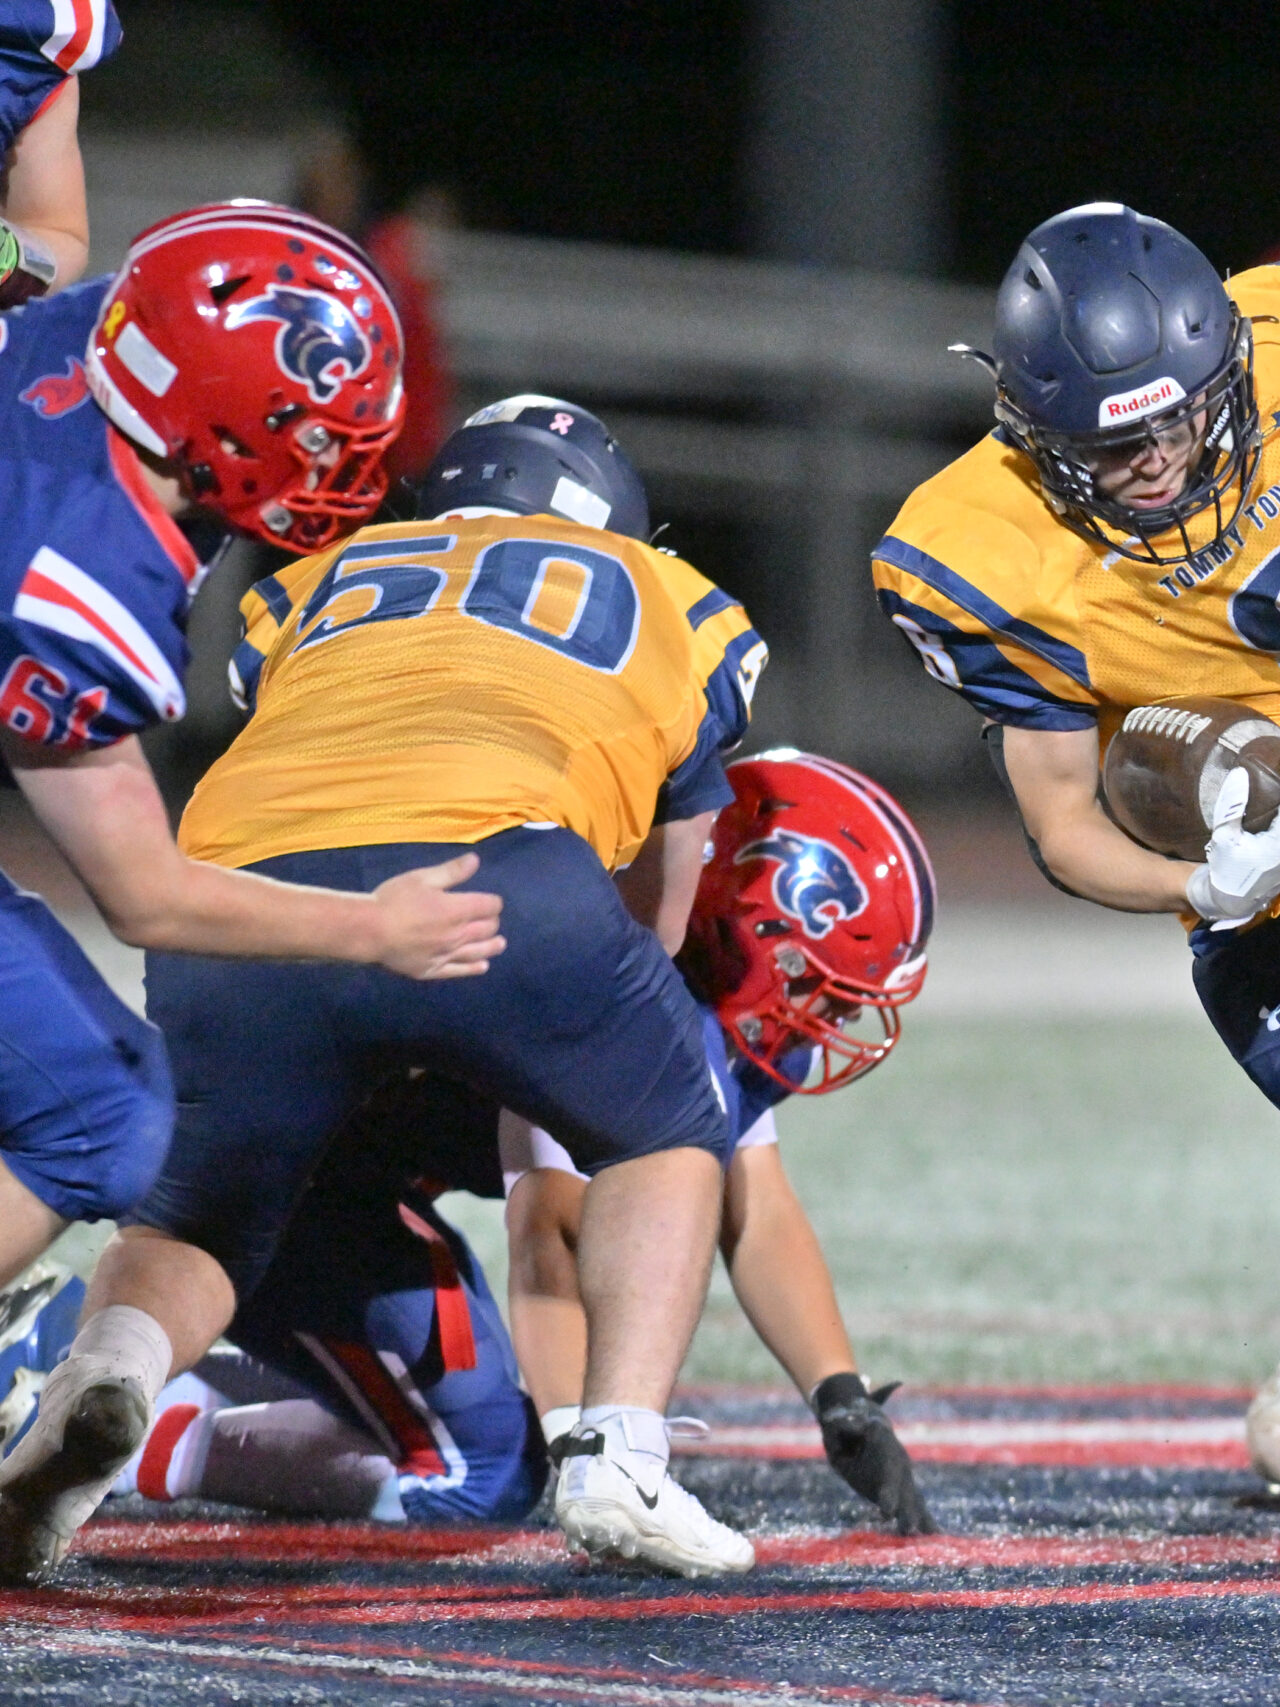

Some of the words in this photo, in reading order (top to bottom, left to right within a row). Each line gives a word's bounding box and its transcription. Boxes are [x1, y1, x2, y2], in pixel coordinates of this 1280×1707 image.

[1107, 384, 1172, 417] Riddell
[1158, 525, 1245, 598] TOMMY
[287, 533, 642, 676] 50
[0, 654, 110, 745] 61
